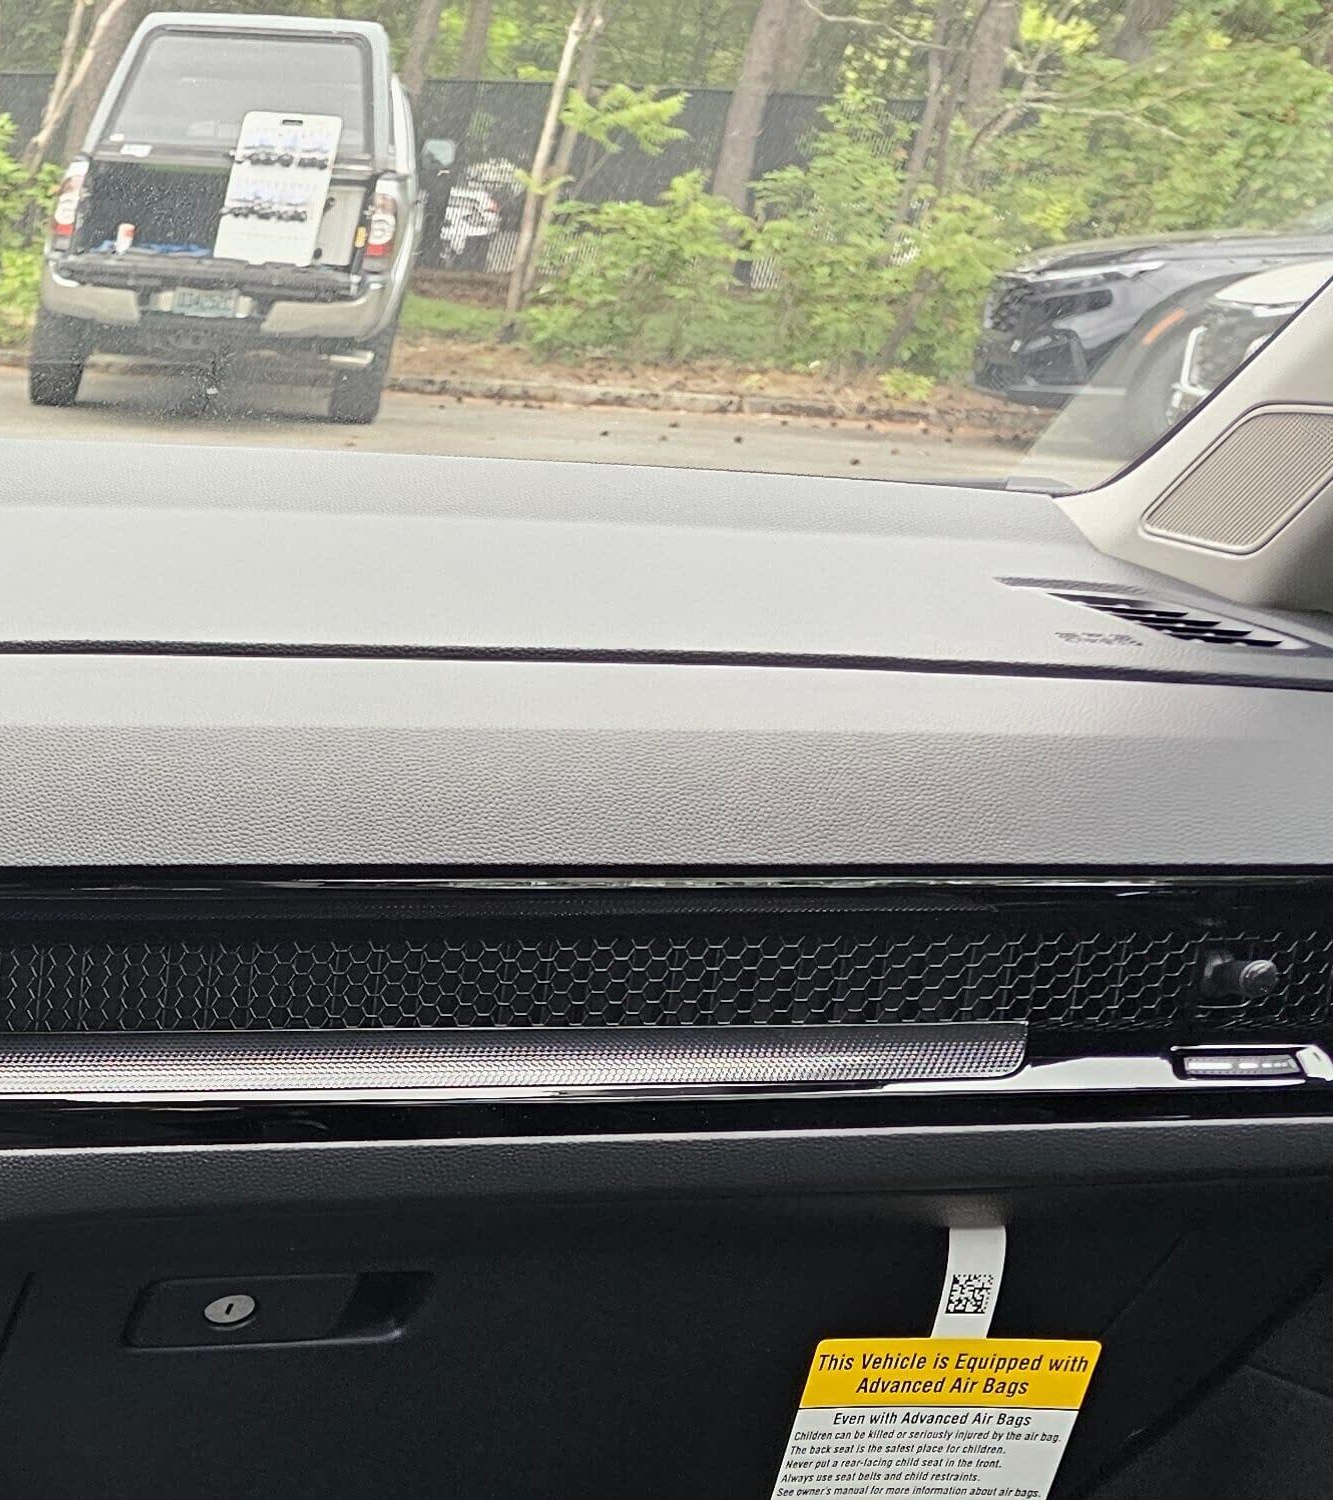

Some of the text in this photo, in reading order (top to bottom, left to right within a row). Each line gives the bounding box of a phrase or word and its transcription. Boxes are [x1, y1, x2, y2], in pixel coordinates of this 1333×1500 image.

[818, 1353, 1089, 1374] This Vehicle is Equipped with
[855, 1377, 1029, 1397] Advanced Air Bags
[833, 1411, 1032, 1428] Even with Advanced Air Bags
[794, 1430, 1062, 1444] Children can be killed or seriously injured by the air bag.
[790, 1443, 1006, 1455] The back seat is the safest place for children.
[785, 1457, 1002, 1470] Never put a rear-facing child seat in the front.
[780, 1471, 981, 1484] Always use seat belts and child restraints.
[776, 1485, 1041, 1499] See owner's manual for more information about air bags.
